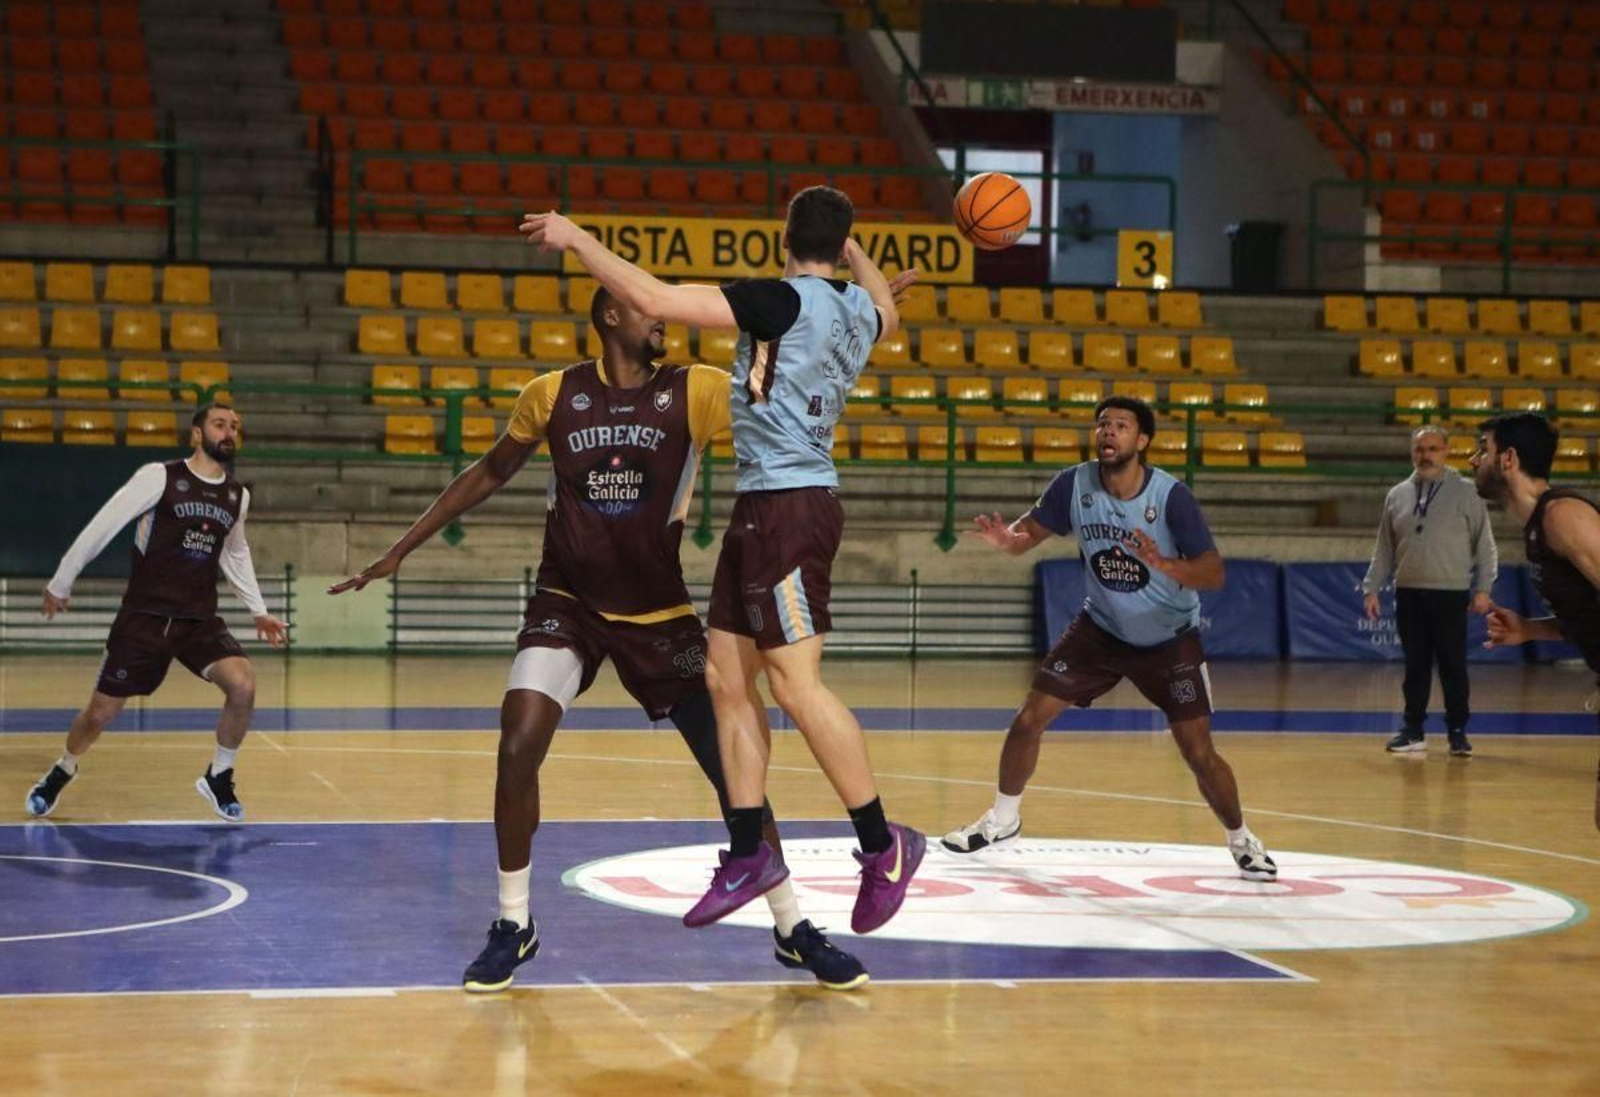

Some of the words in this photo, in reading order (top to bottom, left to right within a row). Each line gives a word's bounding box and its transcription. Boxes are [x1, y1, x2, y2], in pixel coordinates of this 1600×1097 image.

[1055, 86, 1205, 109] EMERXENCIA
[713, 228, 961, 272] BOUVARD
[1133, 240, 1157, 278] 3
[567, 424, 667, 453] OURENSE
[586, 470, 644, 485] Estrella
[588, 485, 639, 500] Galicia
[1080, 523, 1142, 549] OURENS
